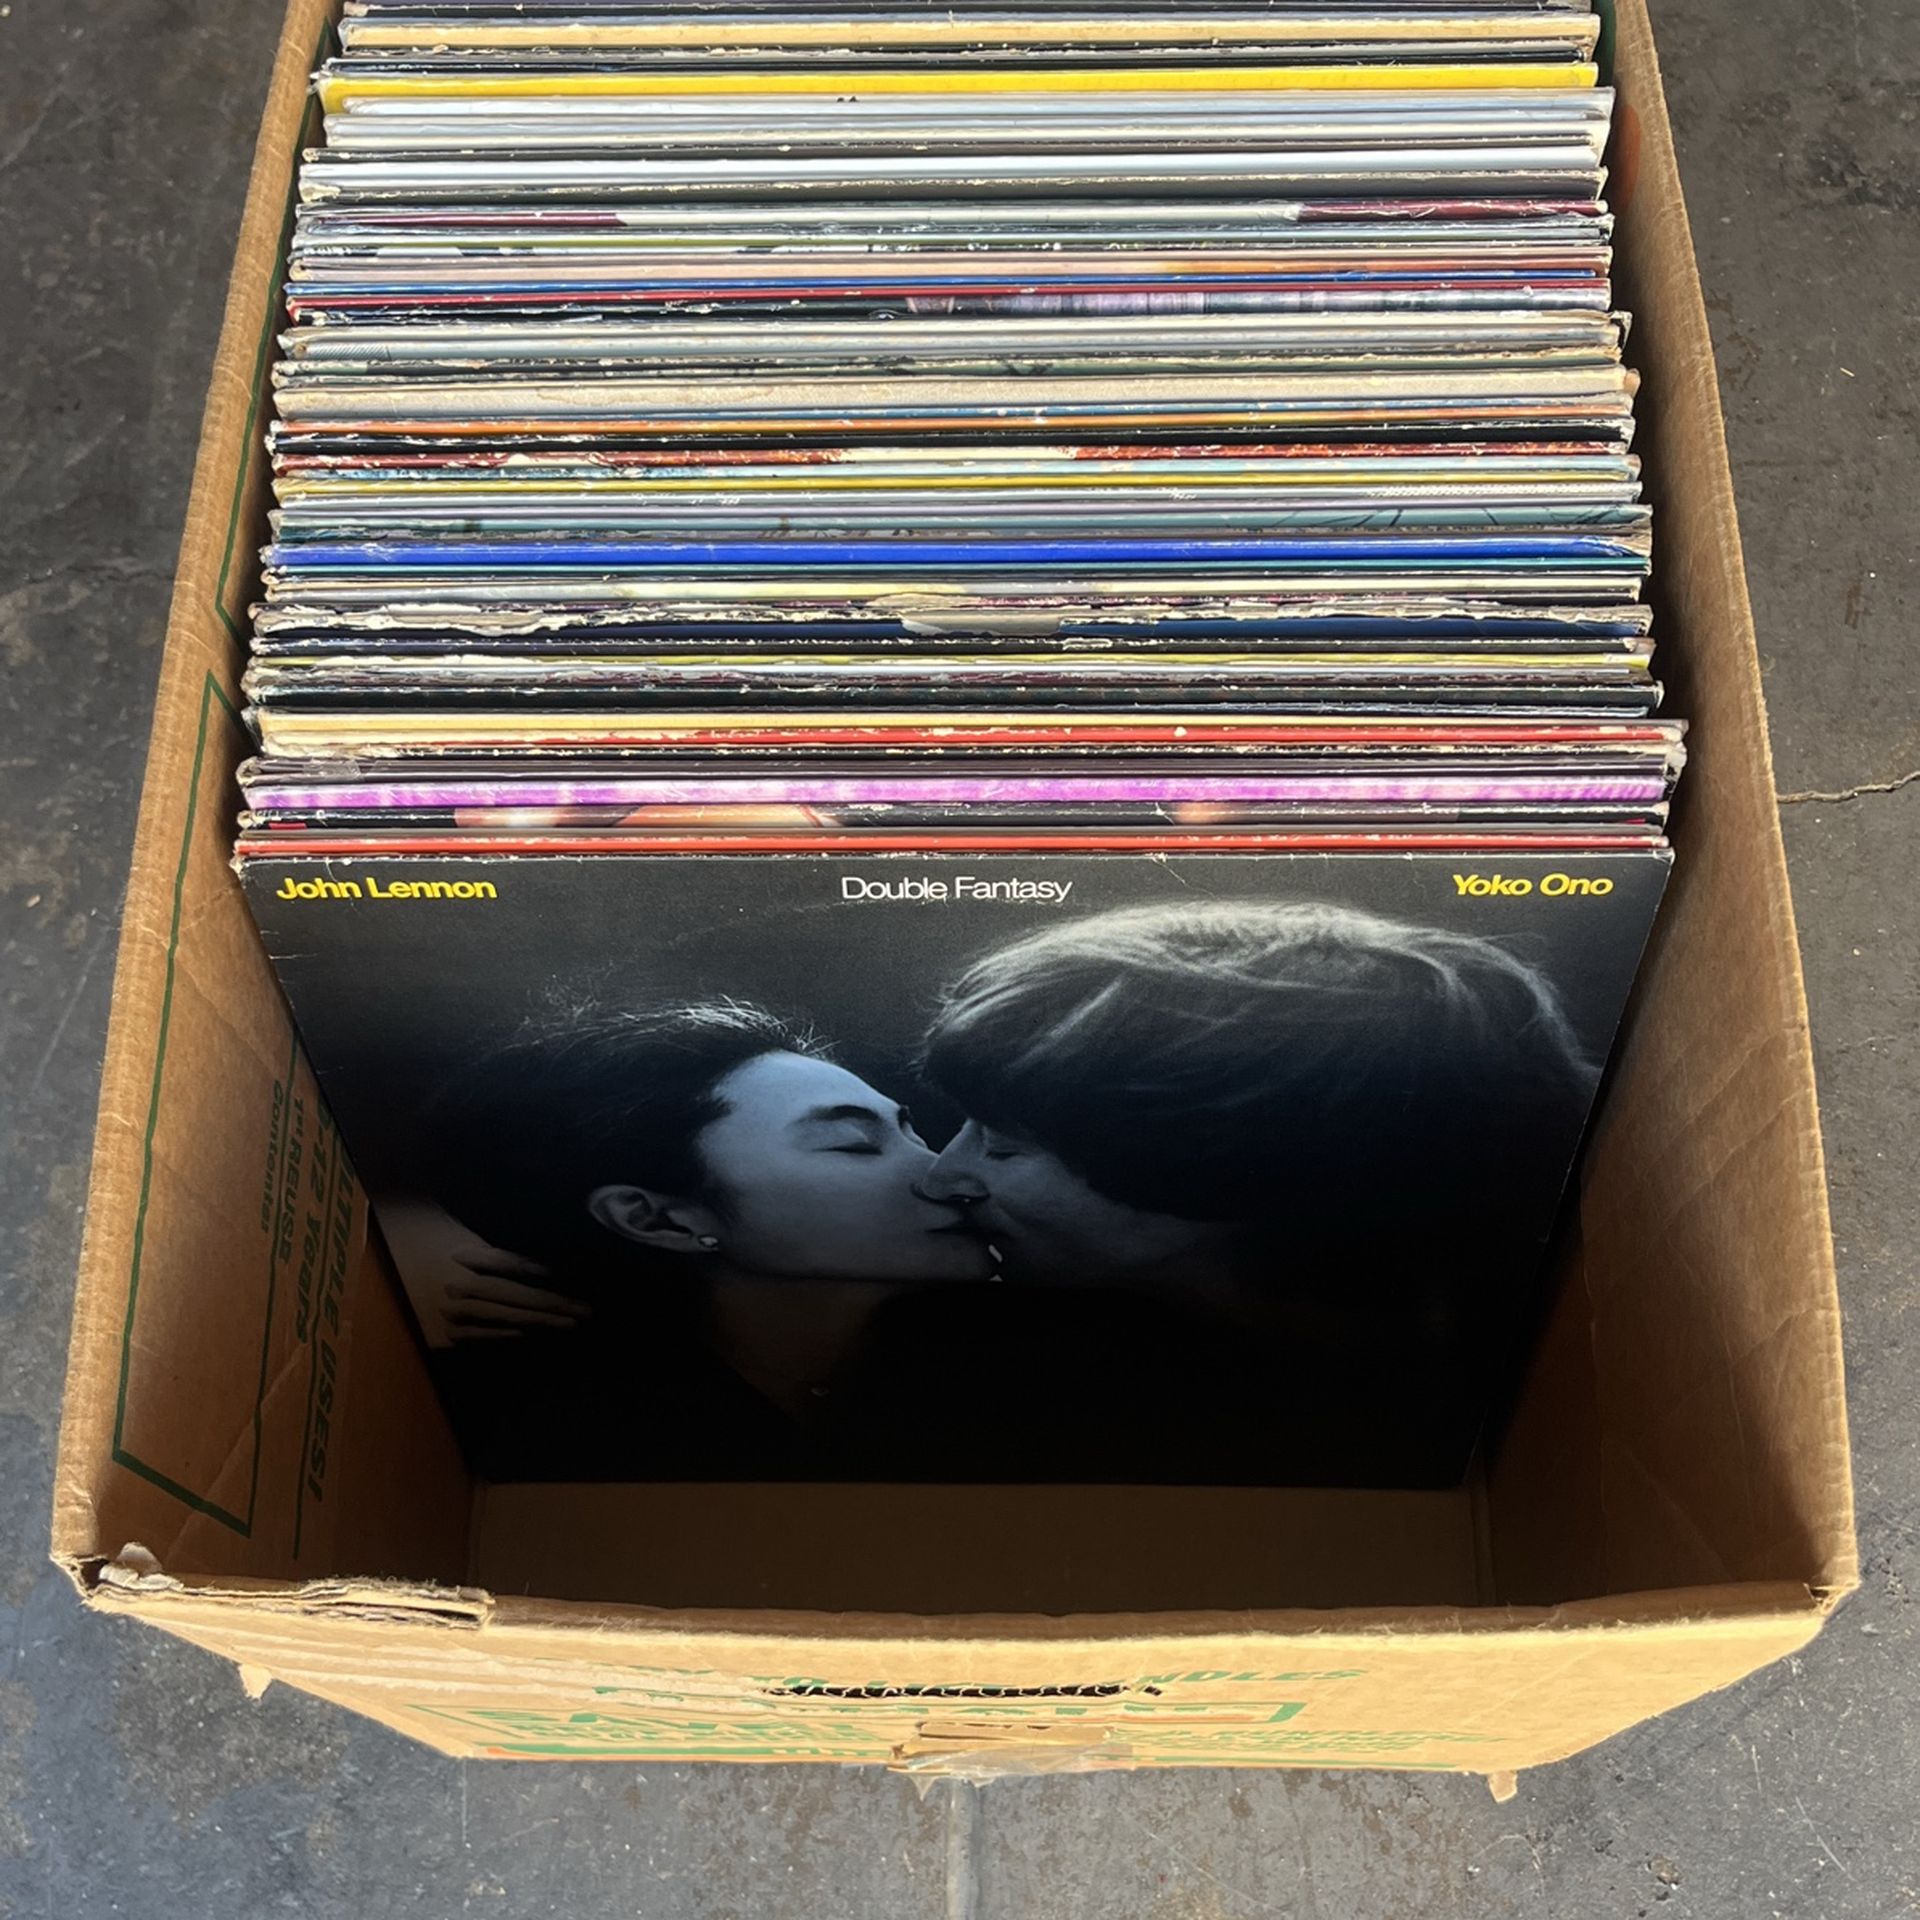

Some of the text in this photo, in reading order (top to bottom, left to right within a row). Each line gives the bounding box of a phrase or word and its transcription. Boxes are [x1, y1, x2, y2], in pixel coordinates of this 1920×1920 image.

[276, 876, 498, 900] John Lennon
[841, 876, 1073, 903] Double Fantasy
[1452, 872, 1614, 897] Yoko Ono
[280, 1137, 302, 1264] REUSE
[297, 1213, 321, 1344] Years
[308, 1340, 337, 1503] USES!
[1100, 1669, 1368, 1684] NDLES
